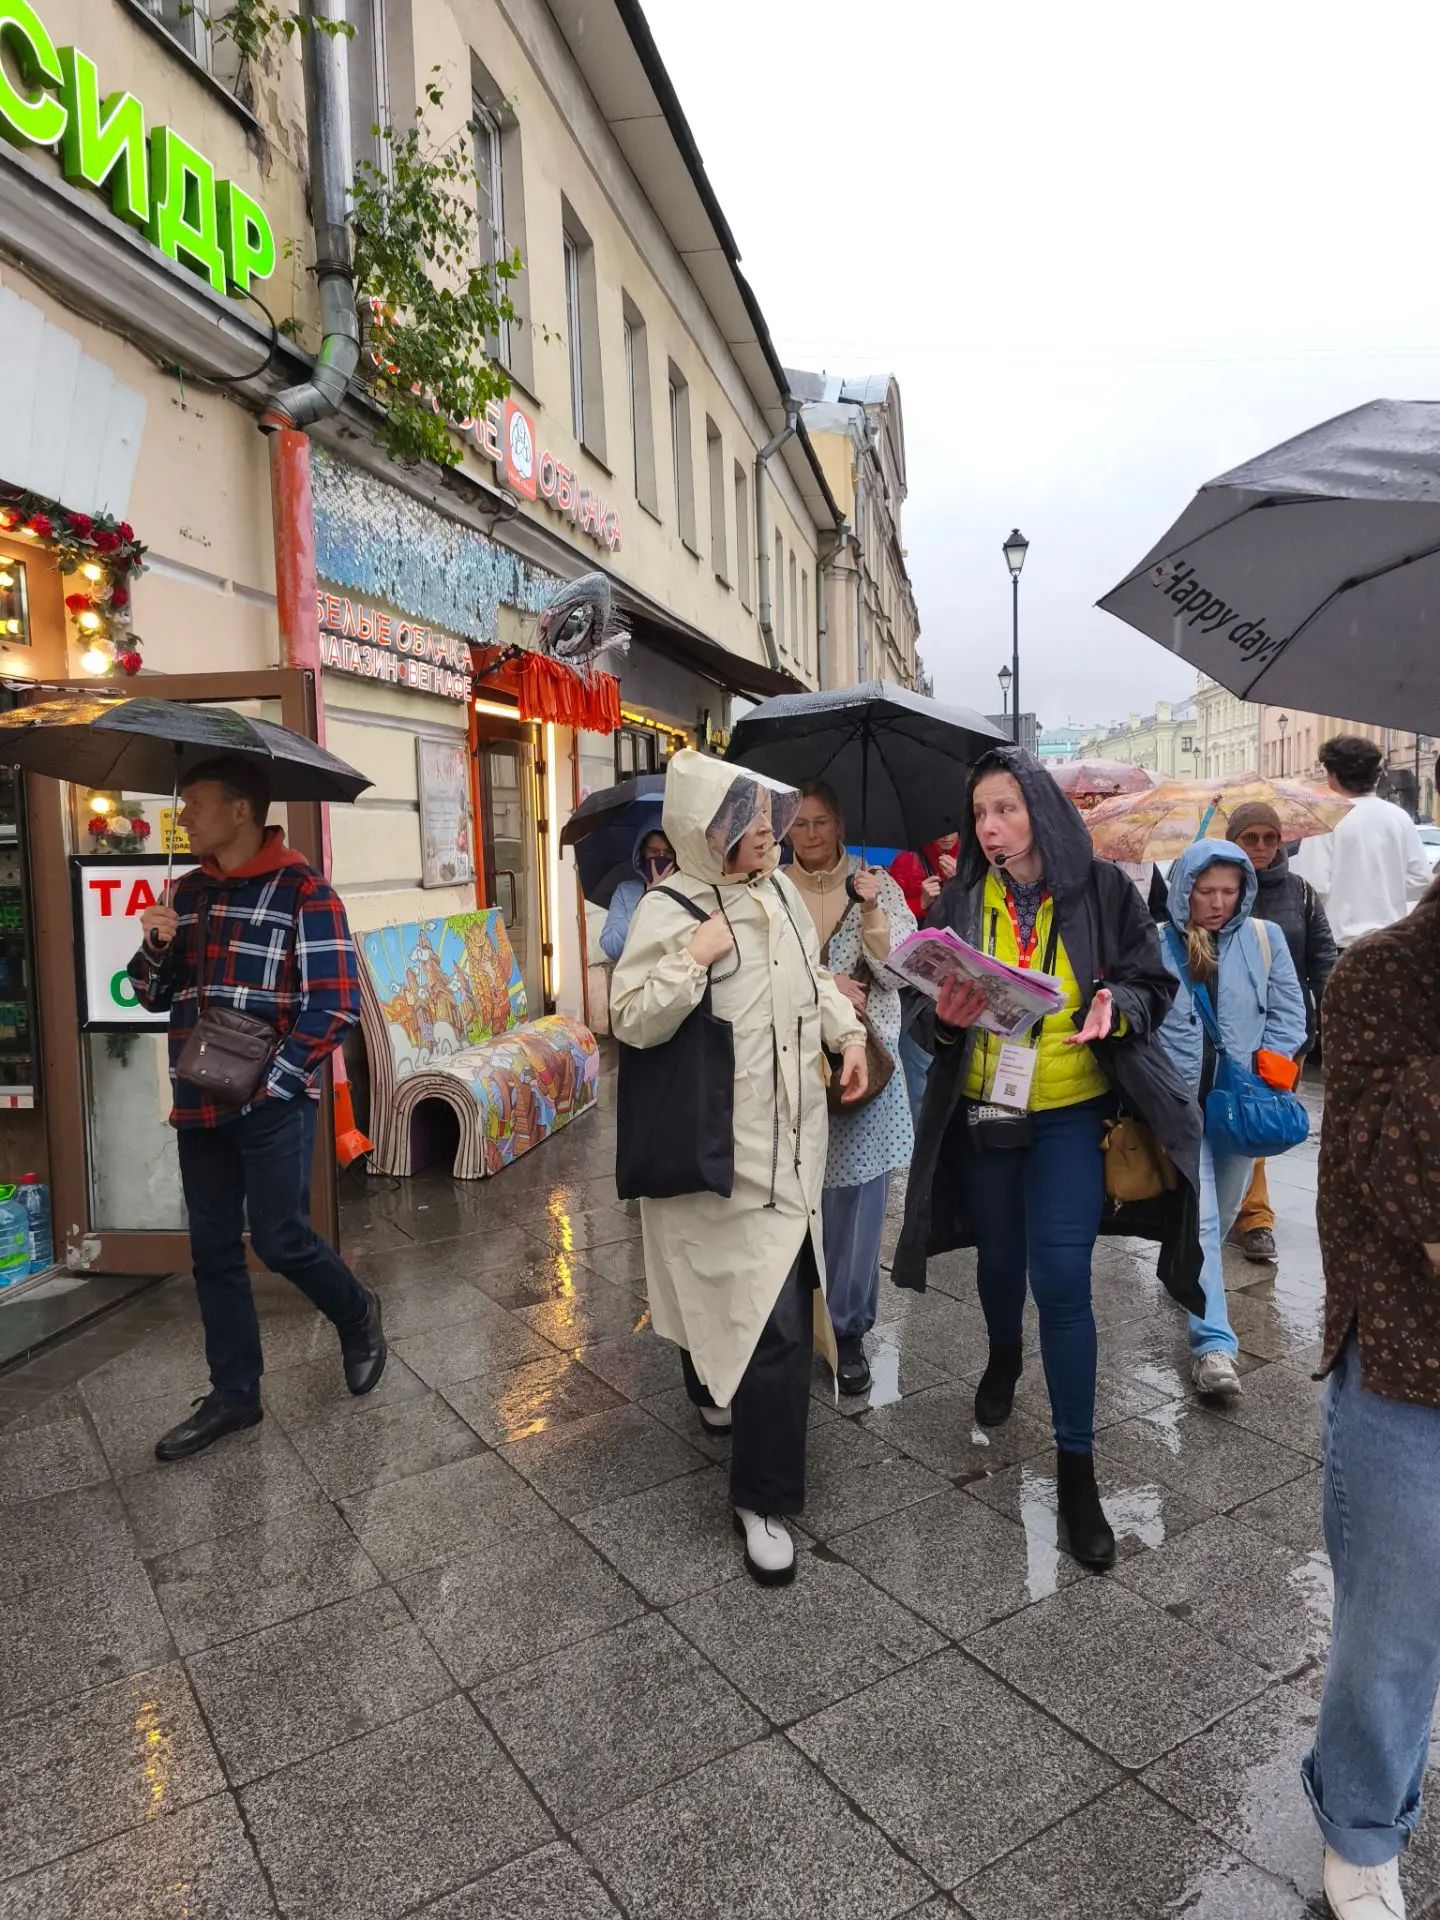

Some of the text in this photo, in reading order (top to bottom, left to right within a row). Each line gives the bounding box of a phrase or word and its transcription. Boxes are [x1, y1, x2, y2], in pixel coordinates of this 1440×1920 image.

[0, 0, 276, 297] СИДР
[539, 450, 623, 553] ОБЛАКА
[396, 620, 474, 672] ОБЛАКА
[1153, 560, 1289, 662] Happy day!
[89, 880, 175, 917] ТА
